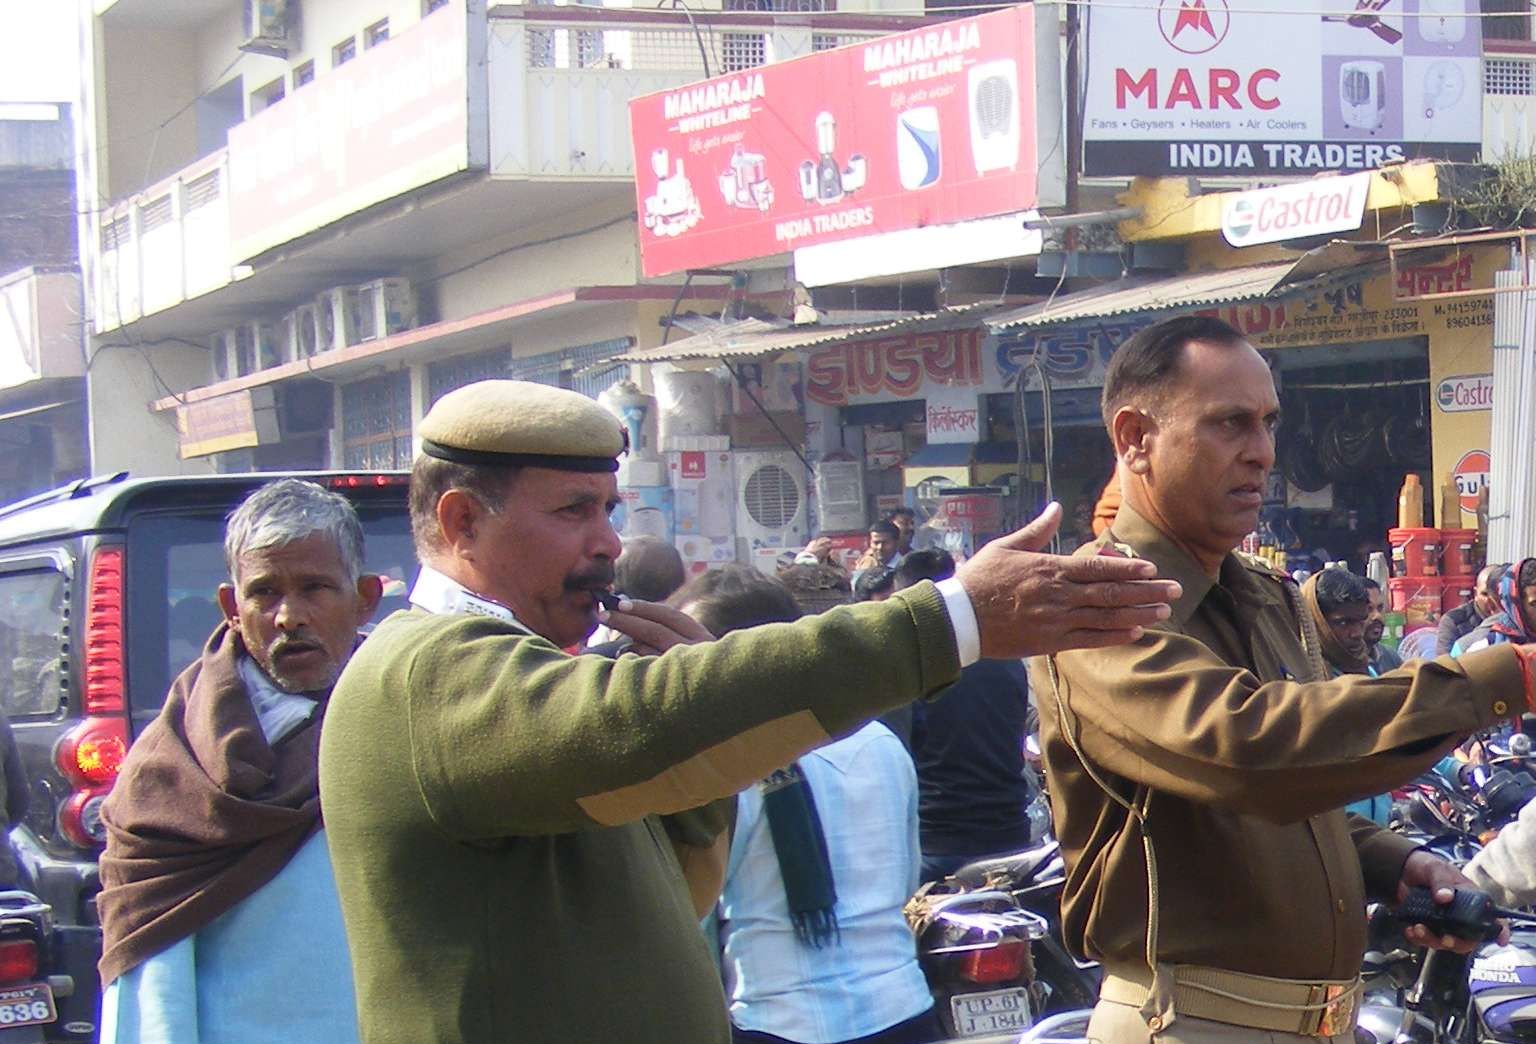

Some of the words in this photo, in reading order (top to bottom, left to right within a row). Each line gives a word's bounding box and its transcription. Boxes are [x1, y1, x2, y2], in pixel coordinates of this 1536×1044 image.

[863, 20, 980, 72] MAHARAJA
[879, 56, 964, 88] WHITELINE
[1116, 68, 1281, 110] MARC
[664, 74, 765, 120] MAHARAJA
[678, 104, 751, 133] WHITELINE
[1091, 119, 1117, 129] Fans
[1130, 118, 1174, 131] Geysers
[1190, 118, 1231, 129] Heaters
[1246, 118, 1261, 129] Air
[1266, 118, 1307, 129] Coolers
[1169, 143, 1254, 168] INDIA
[1263, 143, 1406, 168] TRADERS
[775, 219, 812, 242] INDIA
[813, 206, 873, 235] TRADERS
[1258, 185, 1353, 232] Castrol
